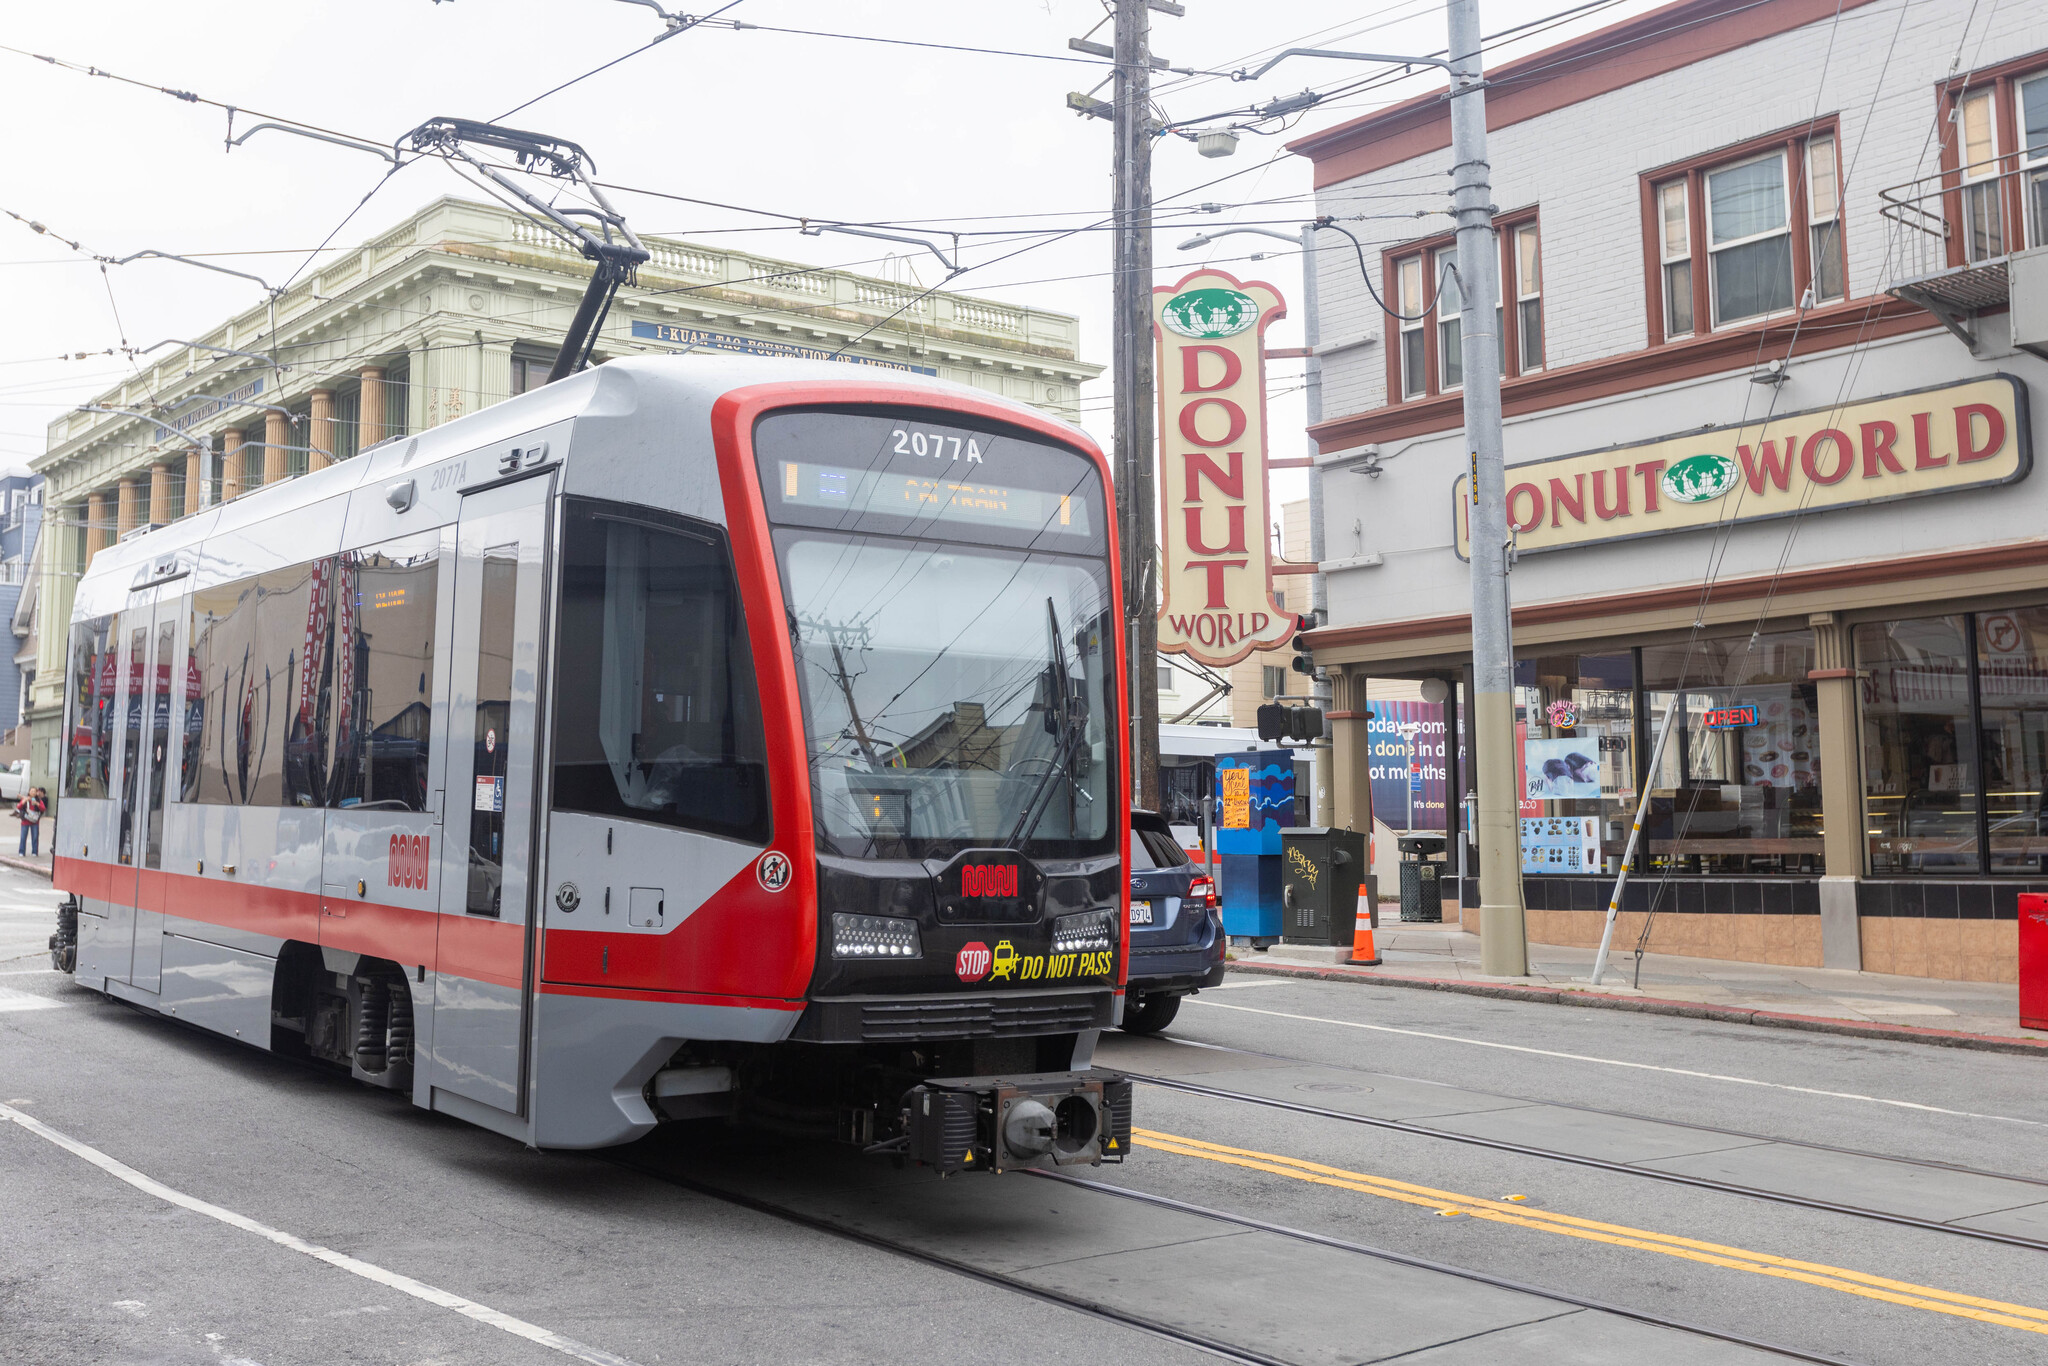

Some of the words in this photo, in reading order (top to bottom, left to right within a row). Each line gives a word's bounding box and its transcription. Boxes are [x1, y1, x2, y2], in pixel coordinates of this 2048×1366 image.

[656, 325, 709, 346] I-KUAN
[715, 334, 741, 351] TAO
[892, 429, 983, 464] 2077A
[430, 460, 467, 492] 2077A
[1178, 345, 1249, 610] DONUT
[1464, 458, 1667, 541] ONUT
[1736, 402, 2007, 497] WORLD
[1169, 612, 1270, 648] WORLD
[1546, 700, 1577, 714] DONUTS
[1704, 709, 1753, 726] OPEN
[1375, 740, 1415, 757] done
[1418, 741, 1432, 757] in
[1369, 764, 1386, 780] ot
[1425, 800, 1445, 809] done
[958, 950, 989, 976] STOP
[1020, 955, 1043, 980] DO
[1045, 953, 1077, 979] NOT
[1077, 950, 1113, 977] PASS
